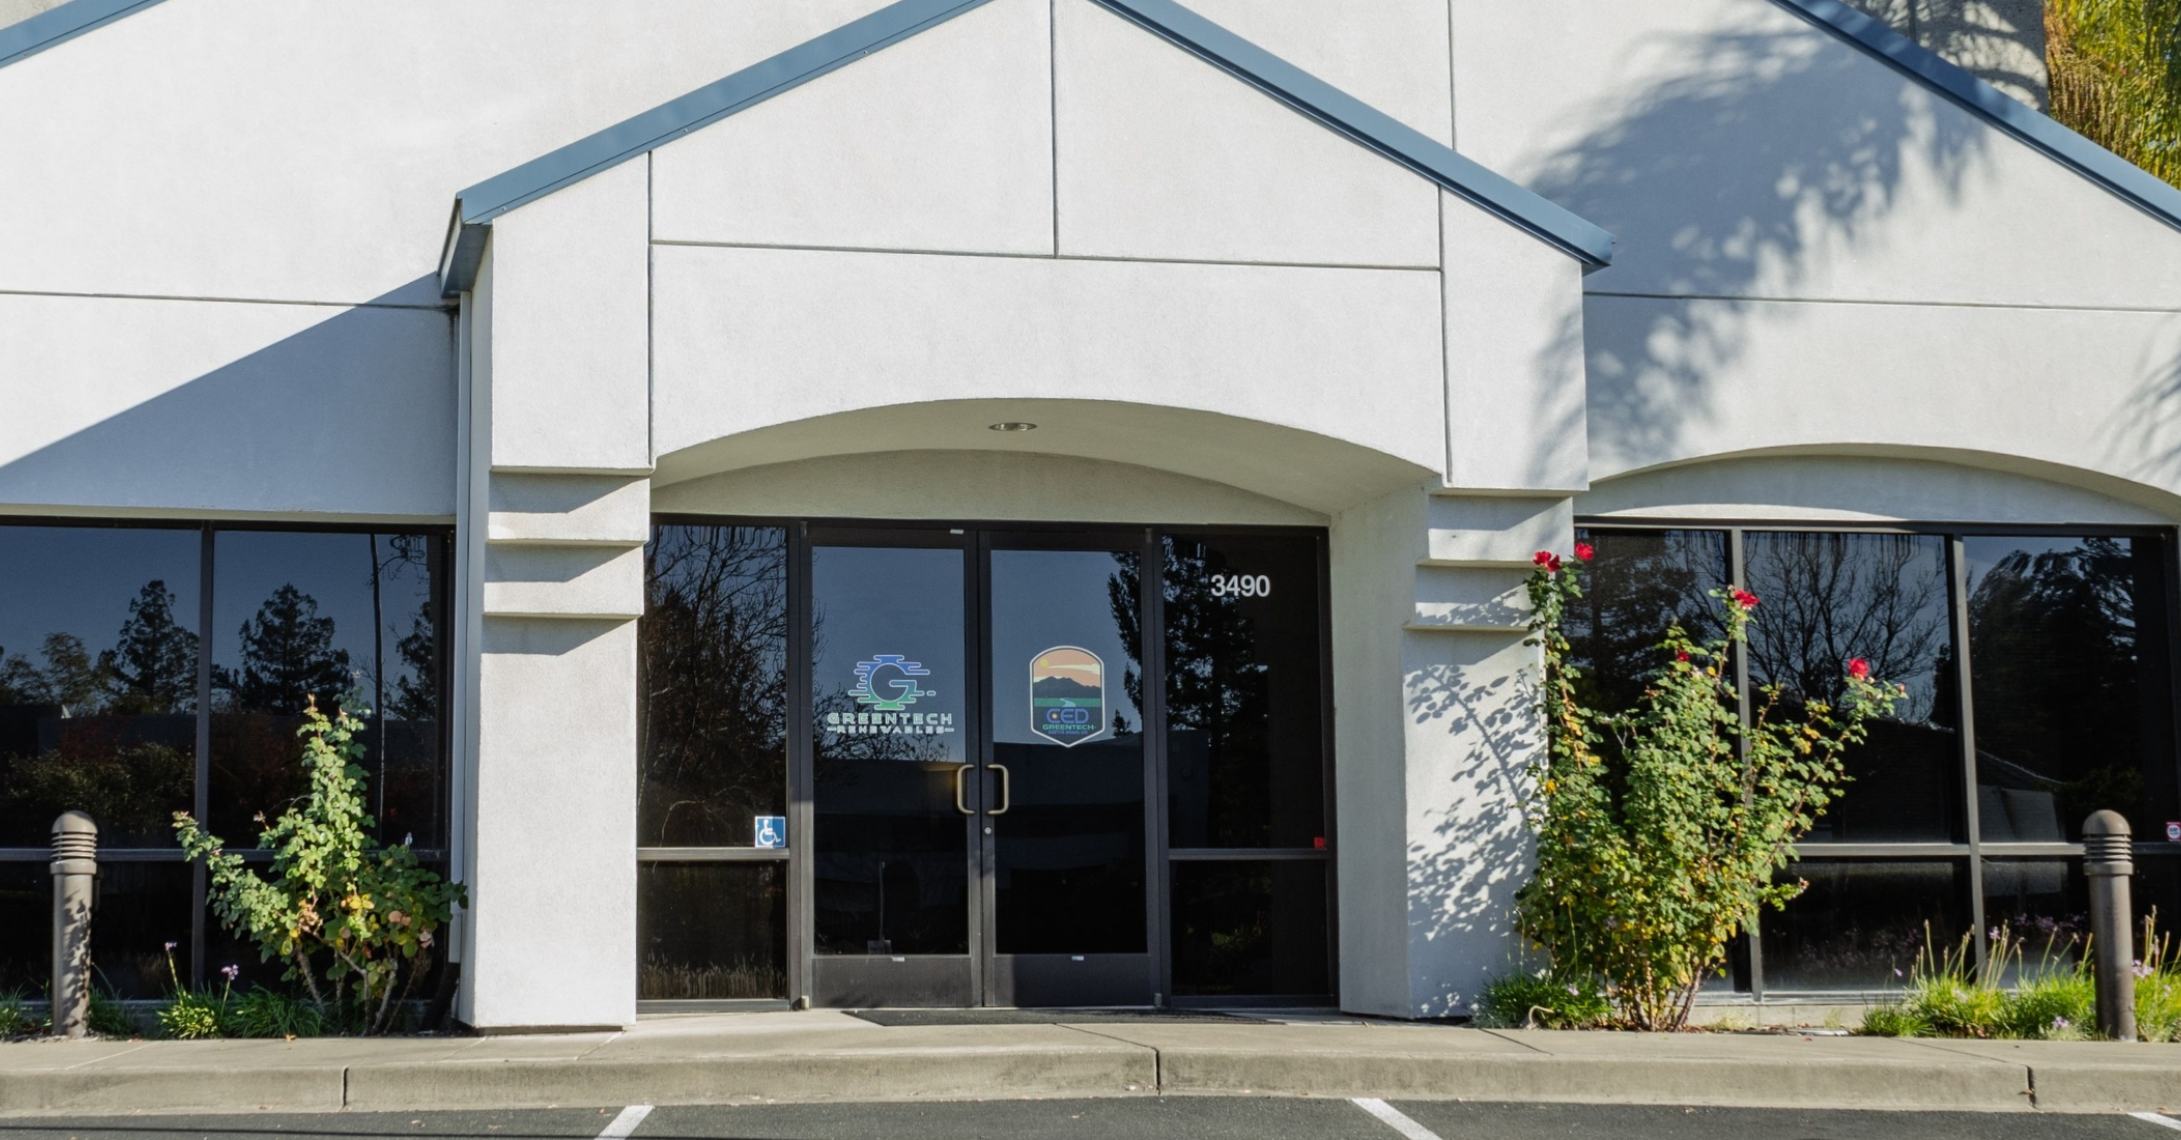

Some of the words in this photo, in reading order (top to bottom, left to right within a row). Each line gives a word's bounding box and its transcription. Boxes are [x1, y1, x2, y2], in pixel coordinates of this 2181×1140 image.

[1210, 574, 1271, 597] 3490
[826, 712, 953, 725] GREENTECH
[1046, 708, 1089, 724] CED
[836, 725, 945, 734] RENEWABLES
